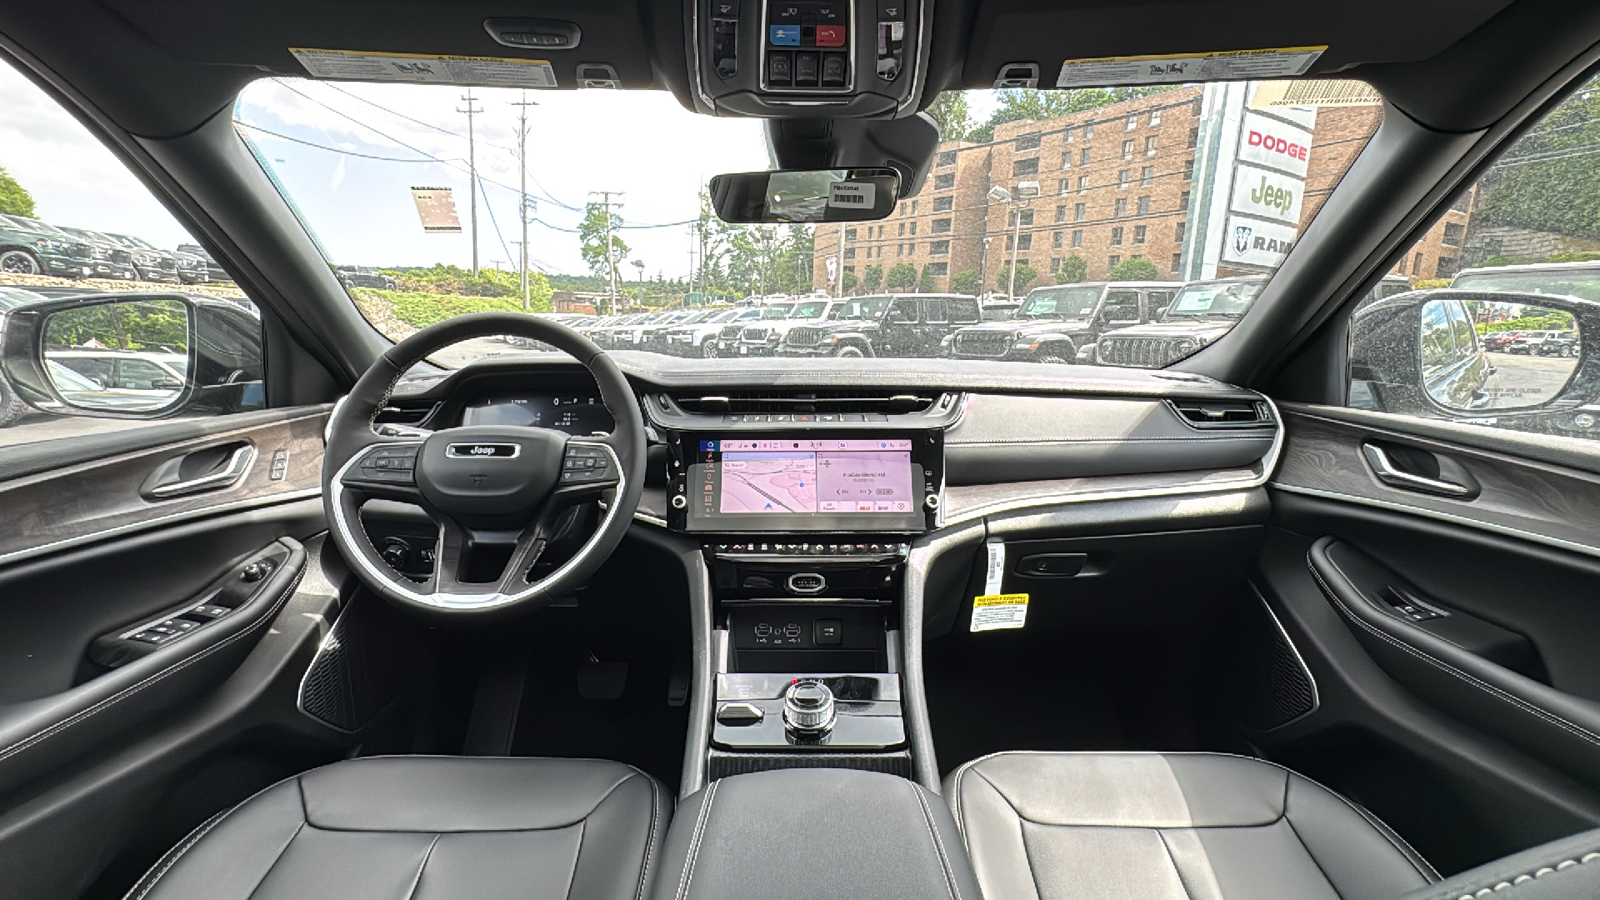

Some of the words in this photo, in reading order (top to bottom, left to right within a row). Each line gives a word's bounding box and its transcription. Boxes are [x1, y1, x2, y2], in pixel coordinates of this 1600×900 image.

[1248, 130, 1308, 162] DODGE
[1251, 176, 1292, 215] Jeep
[470, 446, 496, 455] Jeep
